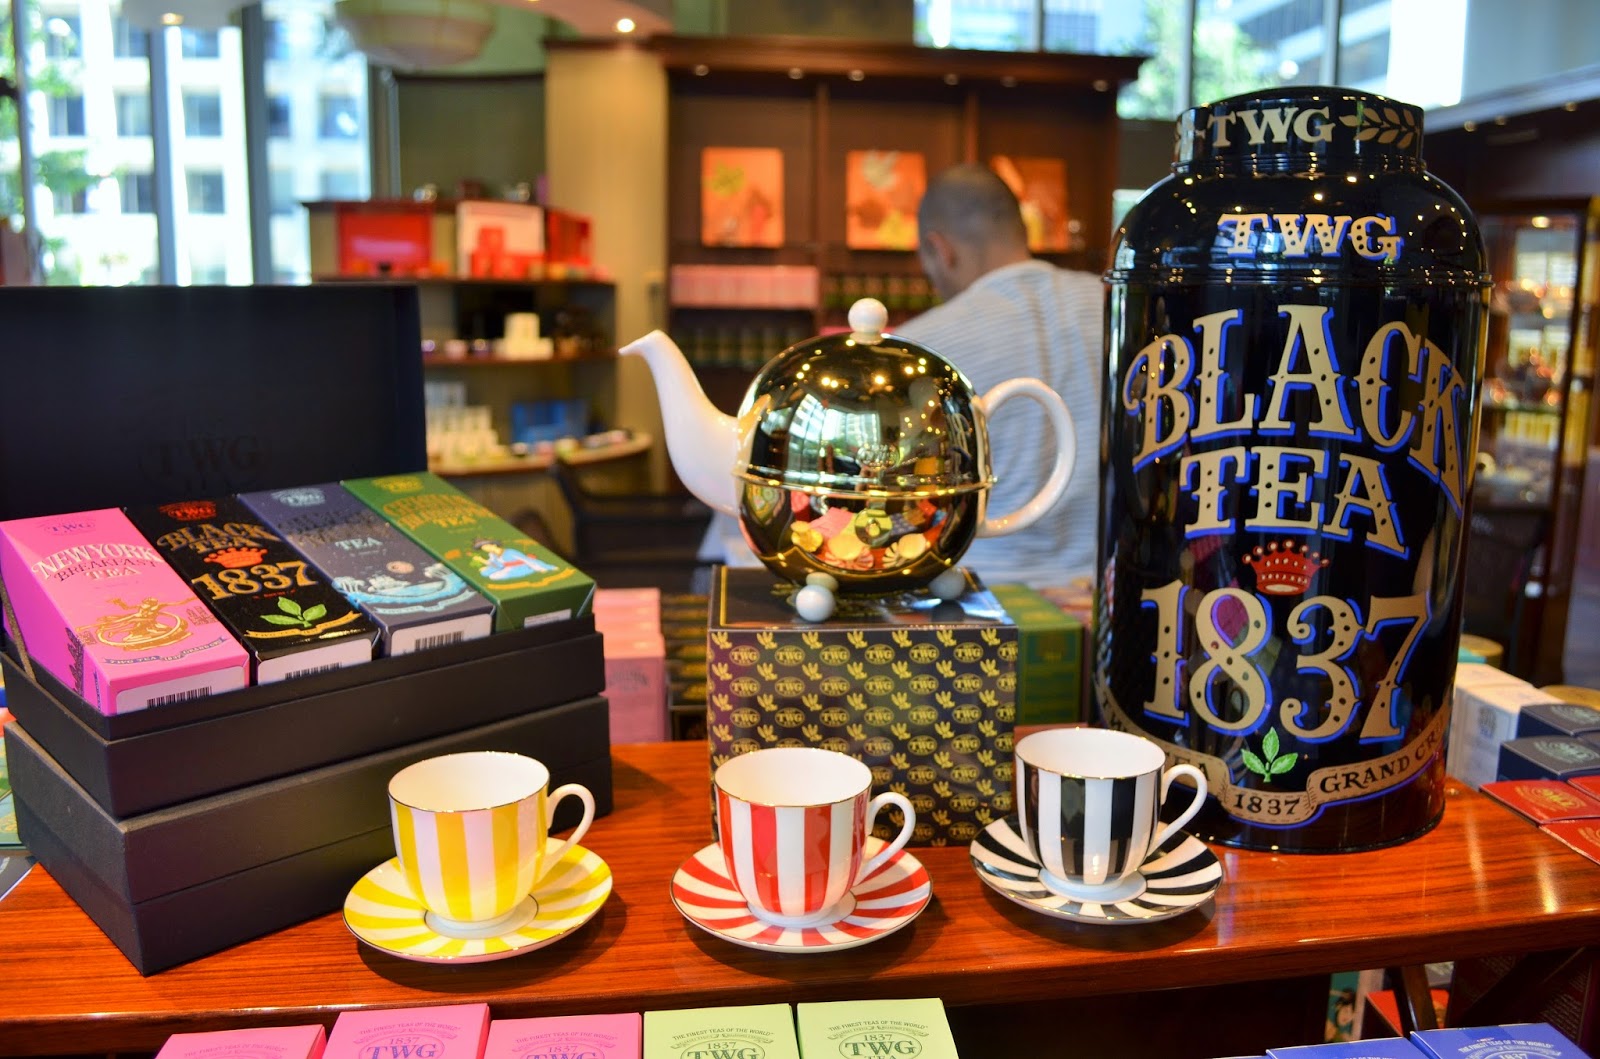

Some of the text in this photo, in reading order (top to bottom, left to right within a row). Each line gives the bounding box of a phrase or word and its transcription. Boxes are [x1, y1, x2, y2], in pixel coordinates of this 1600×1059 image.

[1207, 106, 1336, 148] TWG
[1215, 213, 1404, 260] TWG
[1123, 304, 1465, 520] BLACK
[1180, 446, 1409, 559] TEA
[157, 522, 281, 551] BLACK
[189, 537, 264, 554] TEA
[335, 537, 383, 550] TEA
[54, 558, 156, 581] BREAKFAST
[85, 566, 141, 580] TEA
[191, 560, 319, 600] 1837
[731, 651, 757, 661] TWG
[776, 651, 802, 661] TWG
[821, 651, 847, 661] TWG
[866, 650, 892, 660] TWG
[911, 649, 937, 659] TWG
[955, 648, 981, 658] TWG
[1141, 575, 1433, 744] 1837
[731, 682, 757, 692] TWG
[776, 682, 802, 692] TWG
[821, 681, 847, 691] TWG
[866, 681, 892, 691] TWG
[910, 680, 936, 690] TWG
[954, 679, 980, 689] TWG
[731, 713, 757, 723] TWG
[776, 713, 802, 723] TWG
[821, 712, 847, 722] TWG
[866, 712, 892, 722] TWG
[909, 710, 935, 720] TWG
[953, 709, 979, 719] TWG
[865, 742, 891, 752] TWG
[909, 741, 935, 751] TWG
[952, 740, 978, 750] TWG
[1320, 755, 1410, 793] GRAND
[1235, 792, 1300, 816] 1837
[390, 1036, 420, 1044] 1837
[366, 1044, 436, 1059] TWG
[844, 1040, 916, 1056] TWG
